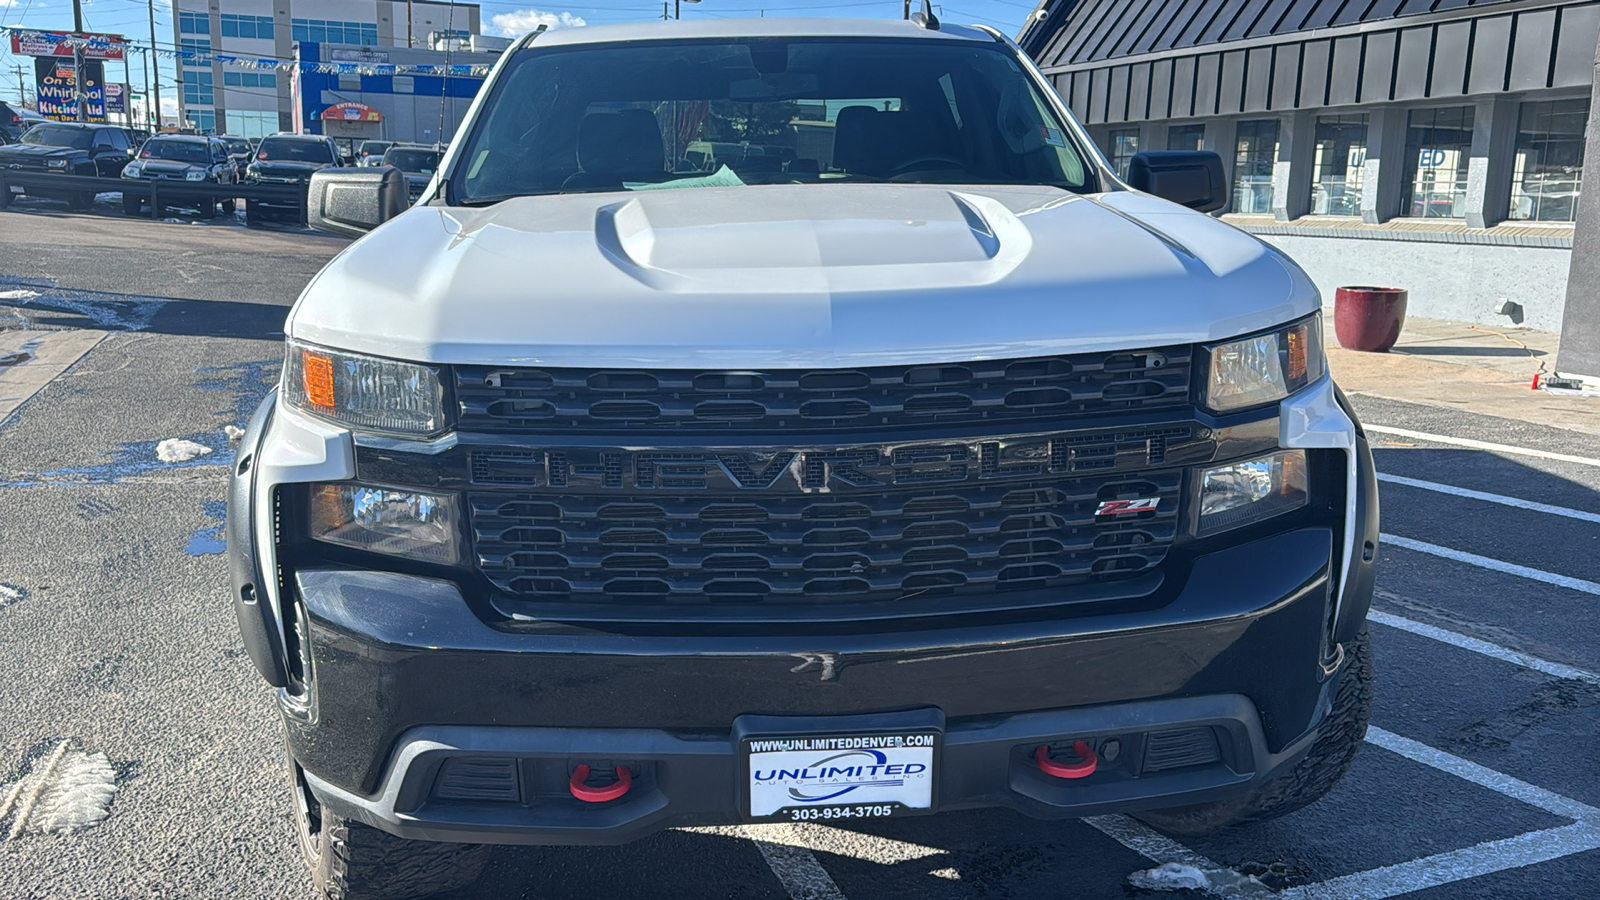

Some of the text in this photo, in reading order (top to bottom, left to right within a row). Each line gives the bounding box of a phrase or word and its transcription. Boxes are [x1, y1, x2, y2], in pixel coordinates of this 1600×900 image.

[43, 76, 95, 86] On Se
[39, 101, 103, 116] KitcheAid
[336, 102, 369, 111] ENTRANCE
[470, 427, 1192, 490] CHEVROLET
[1094, 497, 1161, 516] Z71
[750, 735, 934, 752] WWWUNLIMITEDDENVER.COM
[754, 763, 927, 781] UNLIMITED
[819, 775, 878, 783] SALES
[791, 805, 892, 820] 303-934-3705
